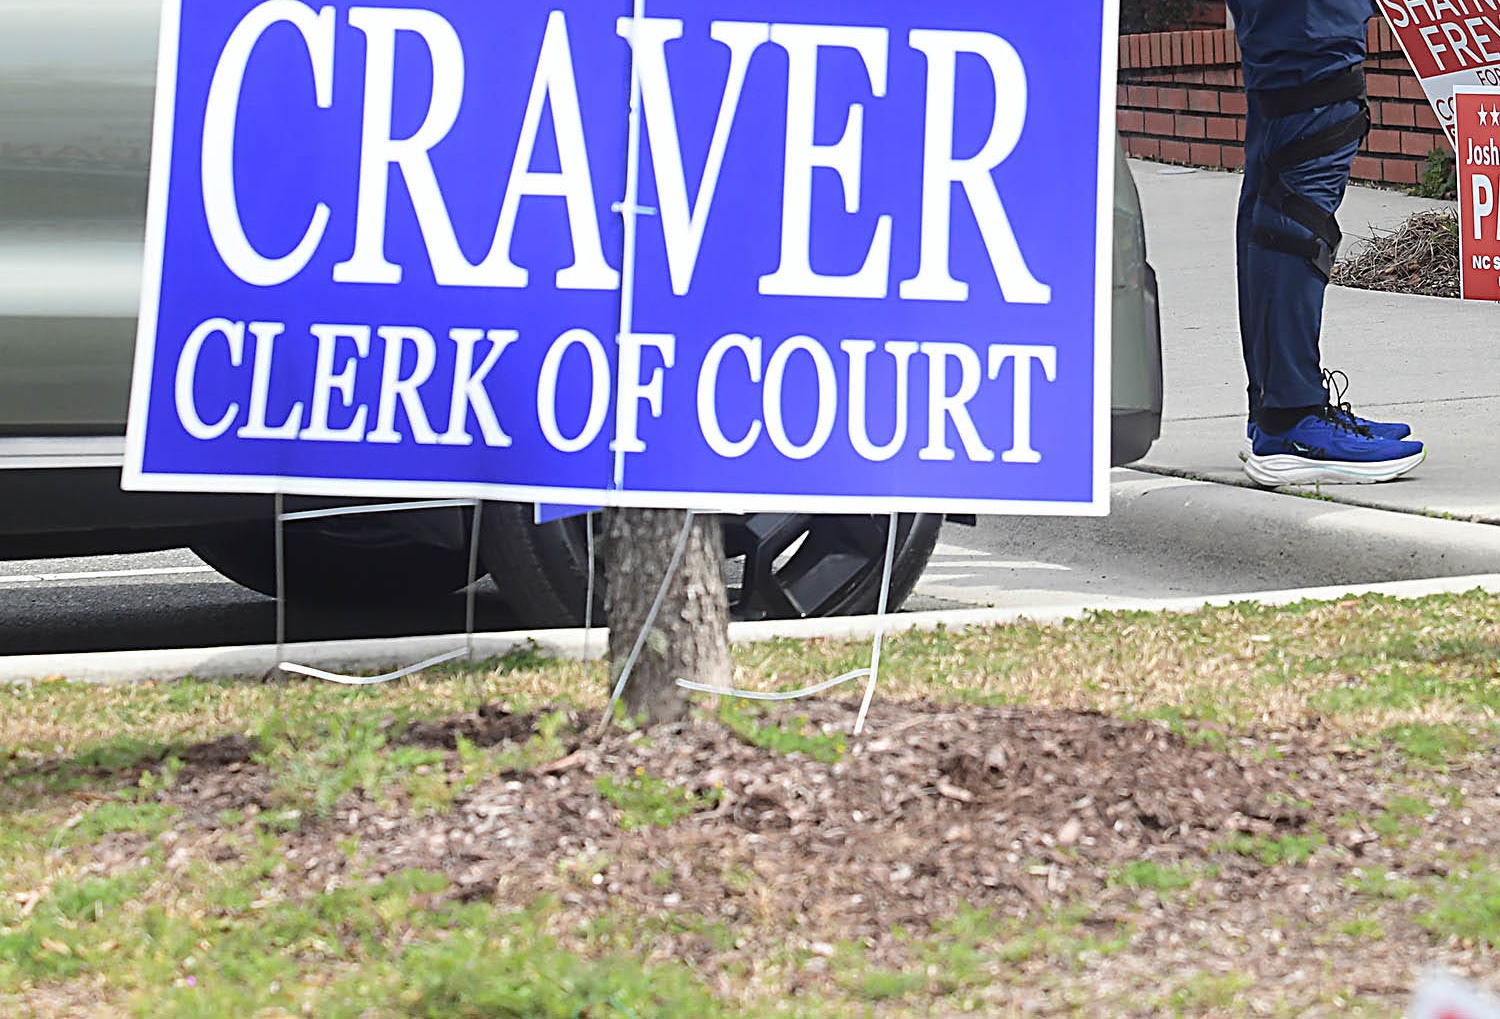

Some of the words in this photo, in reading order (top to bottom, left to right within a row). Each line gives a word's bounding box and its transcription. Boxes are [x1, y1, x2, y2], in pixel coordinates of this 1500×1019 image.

[1472, 255, 1492, 270] NC
[176, 317, 518, 448] CLERK
[536, 326, 675, 454] OF
[698, 333, 1056, 466] COURT
